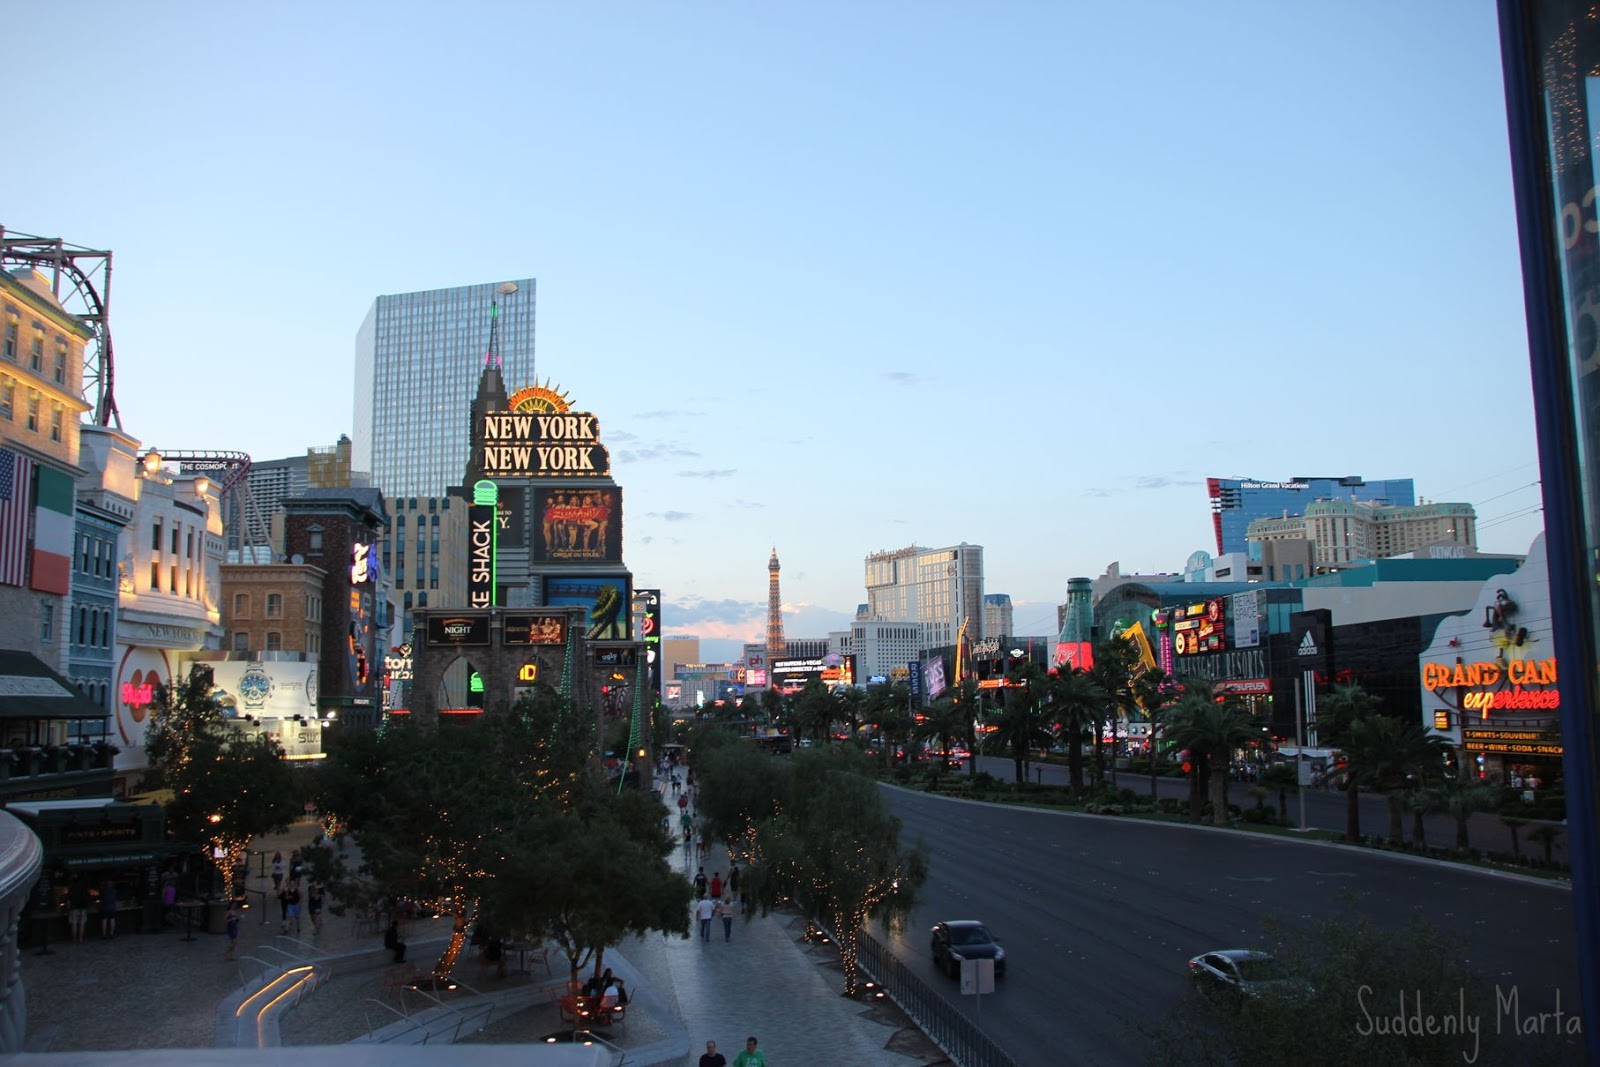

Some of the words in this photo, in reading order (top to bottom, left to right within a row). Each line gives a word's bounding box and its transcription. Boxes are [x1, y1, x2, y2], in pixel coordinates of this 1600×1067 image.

[484, 416, 532, 439] NEW
[537, 416, 594, 439] YORK
[484, 447, 531, 470] NEW
[537, 447, 594, 470] YORK
[552, 507, 601, 519] ZUMANITY
[472, 520, 490, 583] SHACK
[444, 626, 471, 634] NIGHT
[1298, 646, 1318, 655] adidas
[1226, 650, 1265, 680] RESORTS
[1422, 661, 1500, 691] GRAND
[1463, 685, 1560, 720] experience
[1466, 742, 1484, 750] BEER
